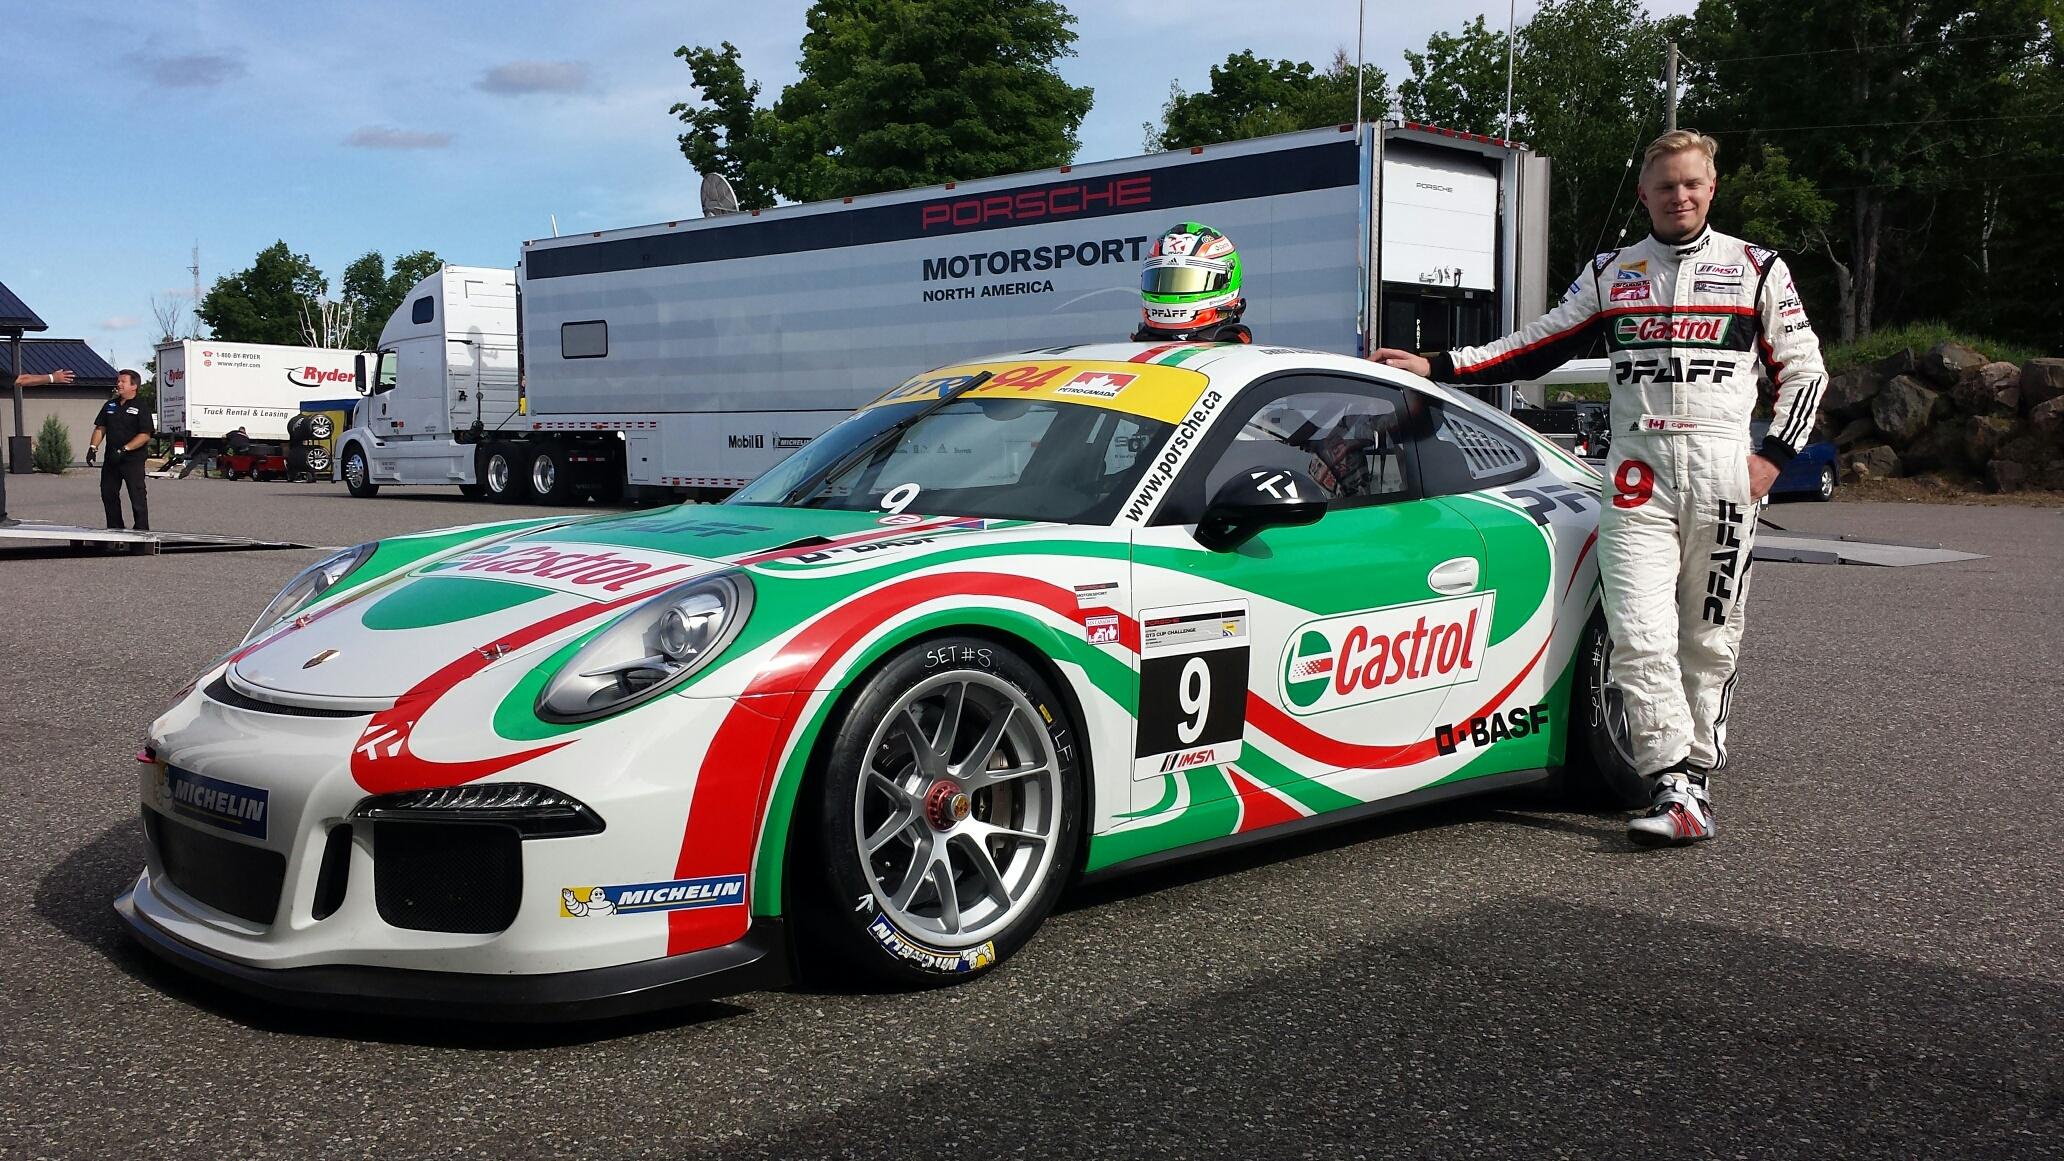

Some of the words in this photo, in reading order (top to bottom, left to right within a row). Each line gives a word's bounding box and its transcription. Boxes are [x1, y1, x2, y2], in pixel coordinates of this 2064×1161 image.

[1416, 182, 1453, 193] PORSCHE
[922, 176, 1152, 230] PORSCHE
[922, 235, 1148, 282] MOTORSPORT
[1712, 267, 1739, 275] IMSA
[923, 286, 975, 302] NORTH
[981, 280, 1054, 297] AMERICA
[1151, 308, 1188, 318] PFAFF
[1638, 317, 1723, 342] Castrol
[303, 366, 356, 383] Ryder
[979, 366, 1072, 392] 94
[1615, 357, 1736, 385] PFAFF
[1058, 387, 1116, 398] PETRO-CANADA
[203, 407, 223, 415] Truck
[226, 408, 250, 417] Rental
[253, 409, 259, 417] &
[260, 410, 289, 419] Leasing
[728, 435, 755, 449] Mobil
[755, 435, 764, 449] 1
[1125, 390, 1224, 523] www.porsche.ca
[1612, 459, 1655, 509] 9
[881, 483, 921, 514] 9
[458, 546, 695, 592] Castrol
[1702, 499, 1743, 625] PFAFF
[925, 646, 957, 667] SET
[961, 646, 992, 667] #8
[1334, 607, 1478, 696] Castrol
[1177, 657, 1211, 744] 9
[1469, 703, 1549, 748] BASF
[1178, 749, 1215, 768] IMSA
[175, 780, 264, 821] MICHELIN
[618, 882, 742, 905] MICHELIN
